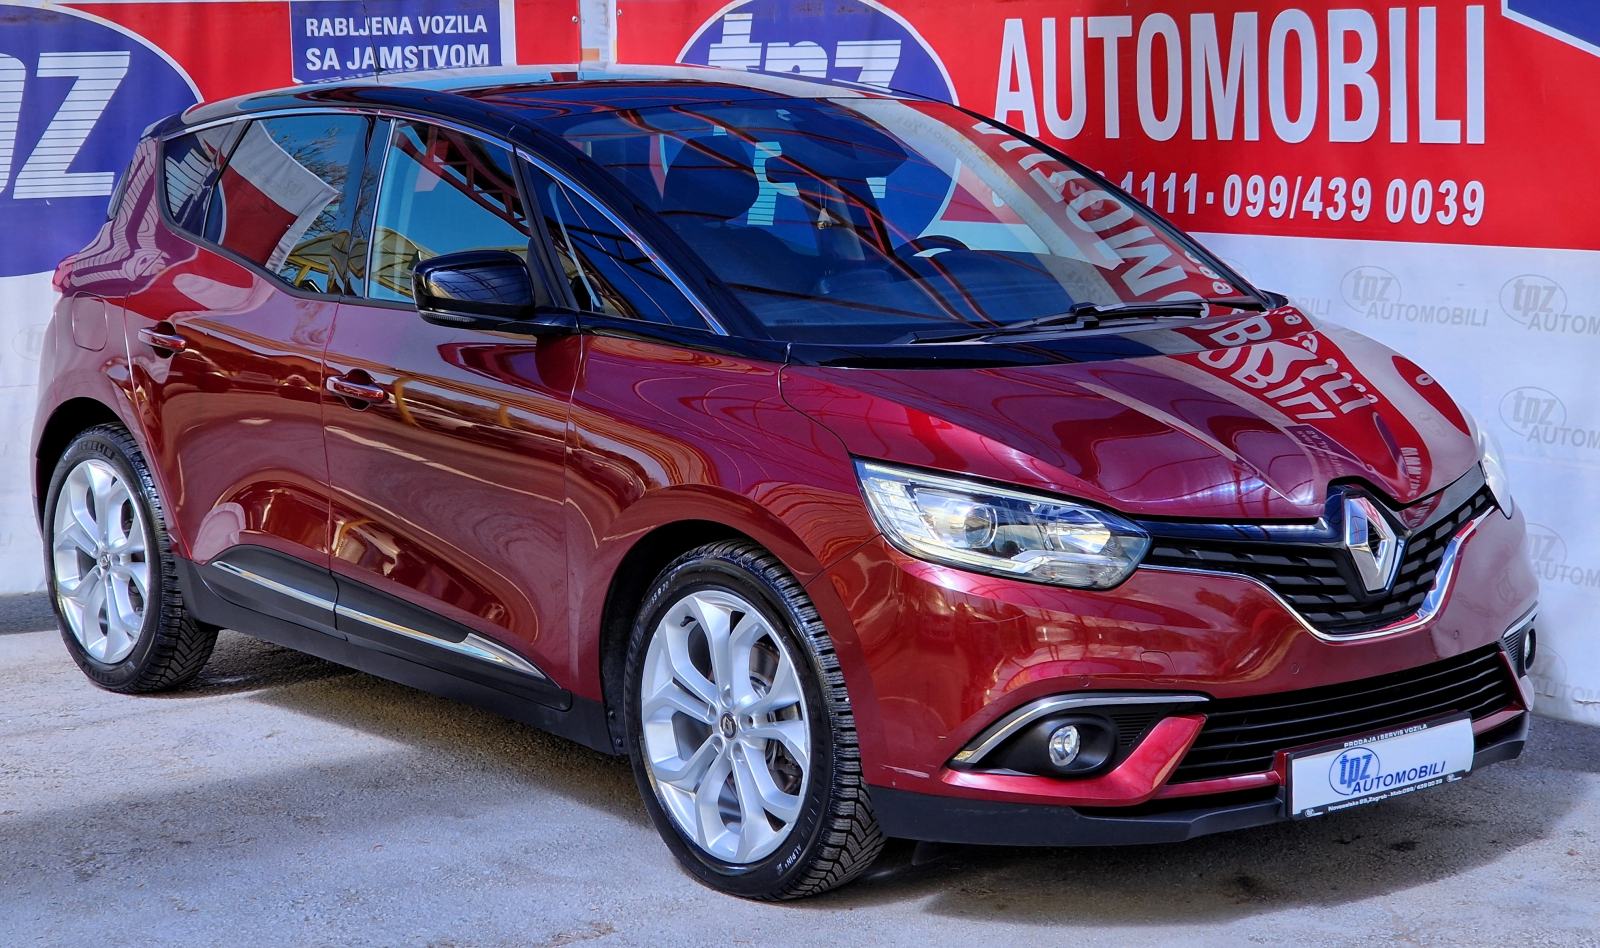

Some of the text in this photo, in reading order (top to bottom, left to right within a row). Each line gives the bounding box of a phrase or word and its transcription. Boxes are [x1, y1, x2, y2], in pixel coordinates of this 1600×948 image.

[305, 14, 488, 37] RABLJENA VOZILA
[305, 43, 489, 71] SA JAMSTVOM
[993, 4, 1486, 145] AUTOMOBILI
[1385, 178, 1486, 227] 0039
[1351, 269, 1393, 306] tpz
[1512, 278, 1558, 318] tpz
[1366, 302, 1489, 328] AUTOMOBILI
[1512, 390, 1558, 430] tpz
[1404, 723, 1428, 734] VOZILA
[1339, 753, 1374, 788] tpz
[1351, 760, 1446, 795] AUTOMOBILI
